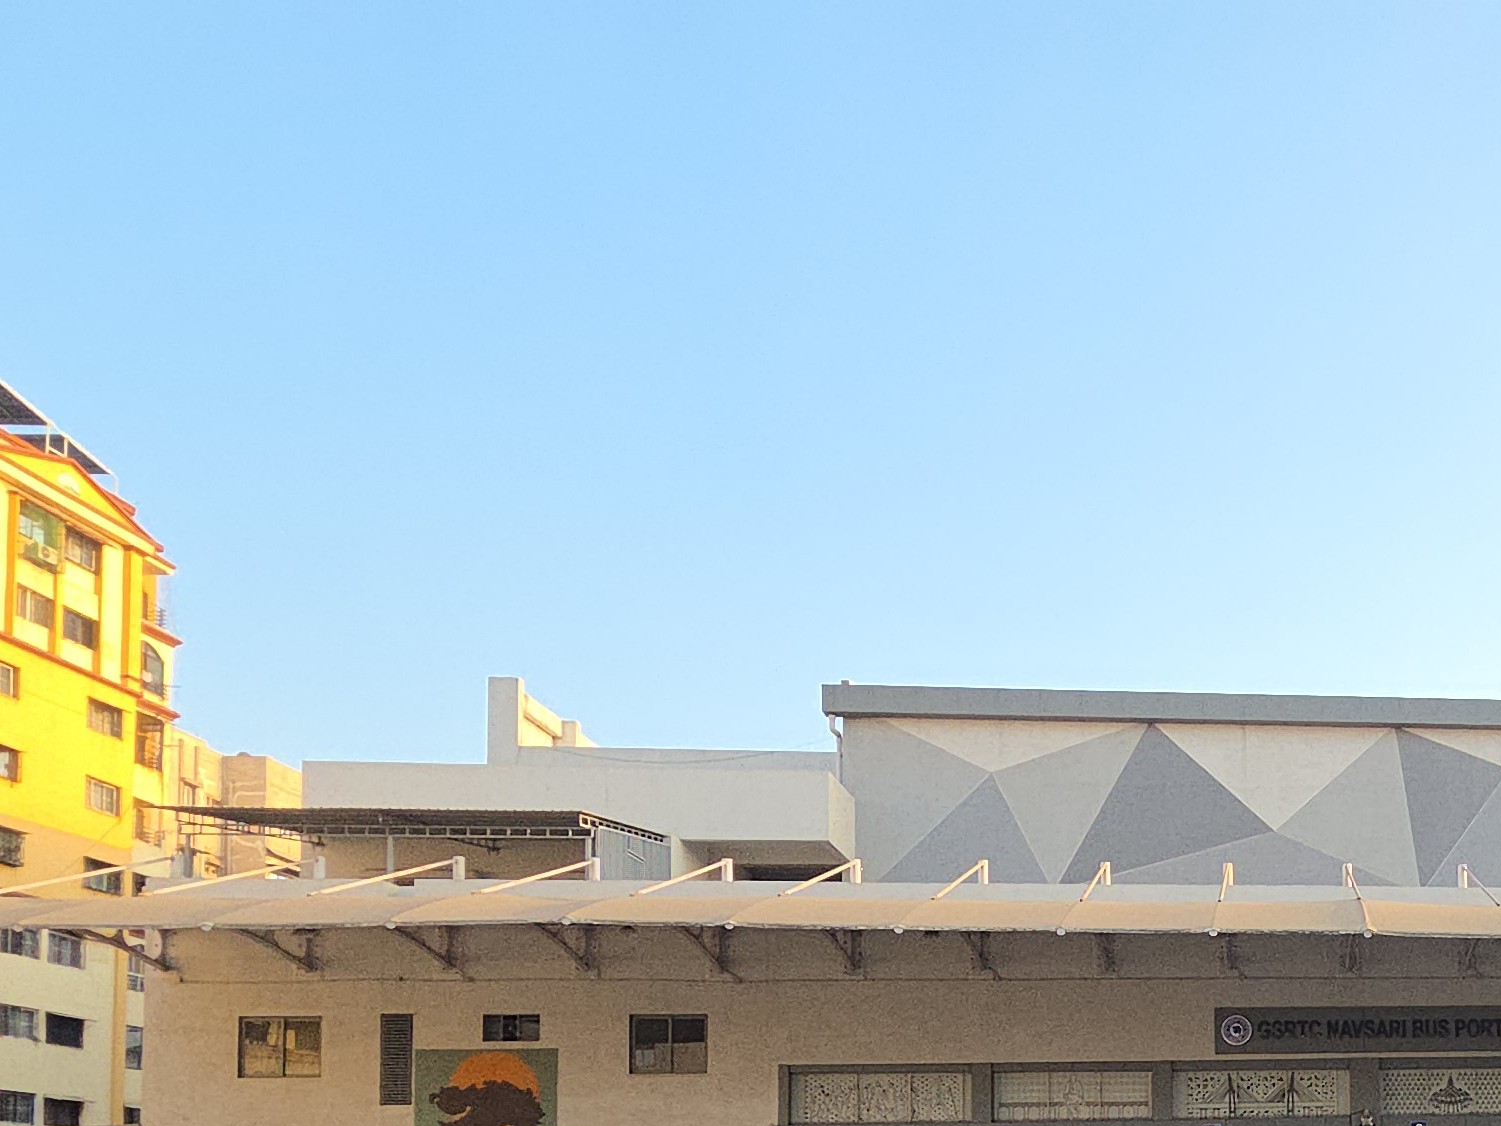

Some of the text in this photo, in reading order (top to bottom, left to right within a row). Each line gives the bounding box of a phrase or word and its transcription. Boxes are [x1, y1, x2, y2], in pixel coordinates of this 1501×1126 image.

[1257, 1018, 1323, 1040] GSRTC
[1327, 1018, 1407, 1040] NAVSARI
[1412, 1018, 1452, 1039] BUS
